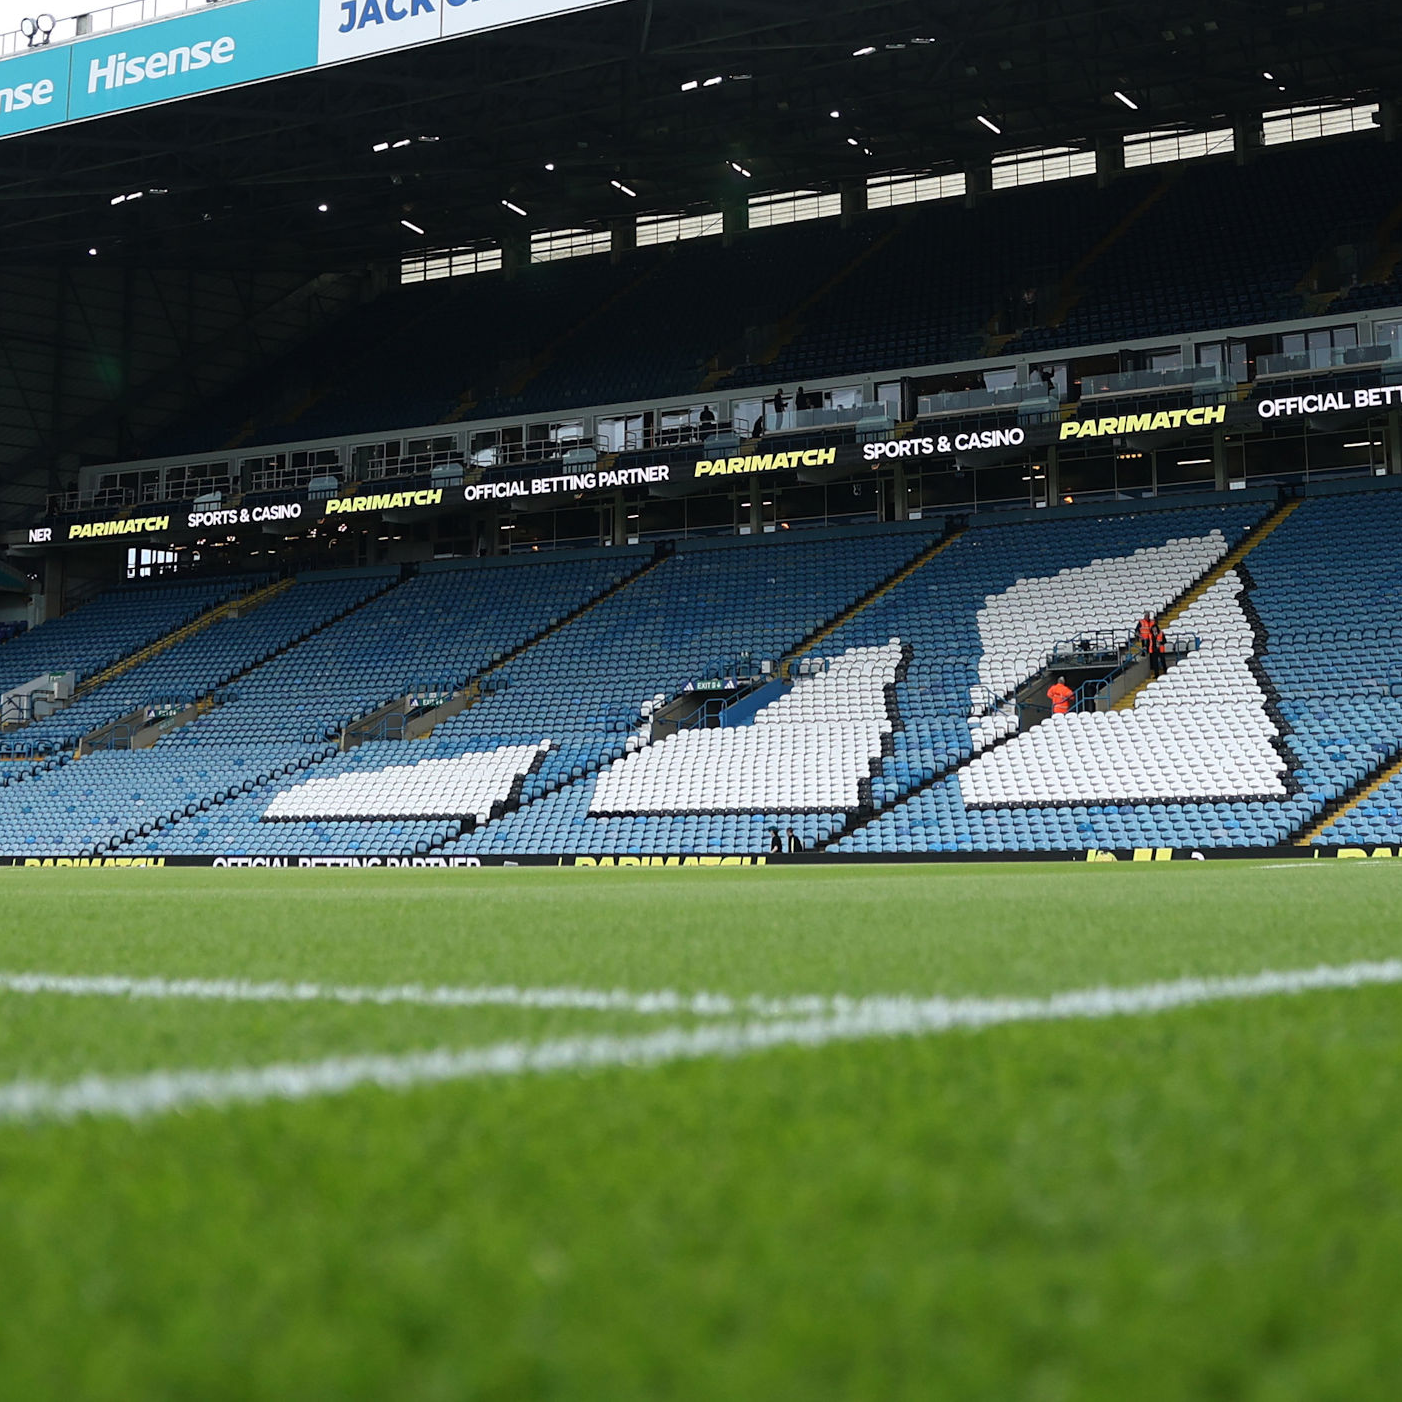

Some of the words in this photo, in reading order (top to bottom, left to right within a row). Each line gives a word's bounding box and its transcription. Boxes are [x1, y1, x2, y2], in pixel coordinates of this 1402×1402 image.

[87, 36, 235, 94] Hisense
[1257, 391, 1351, 419] OFFICIAL
[1059, 405, 1226, 440] PARIMATCH
[863, 437, 934, 461] SPORTS
[936, 435, 951, 452] &
[954, 427, 1025, 451] CASINO
[694, 447, 837, 478] PARIMATCH
[464, 482, 529, 501] OFFICIAL
[531, 473, 595, 494] BETTING
[598, 465, 669, 488] PARTNER
[187, 509, 238, 528] SPORTS
[239, 508, 250, 523] &
[252, 503, 301, 522] CASINO
[325, 488, 442, 515] PARIMATCH
[68, 515, 169, 539] PARIMATCH
[697, 682, 711, 690] EXIT
